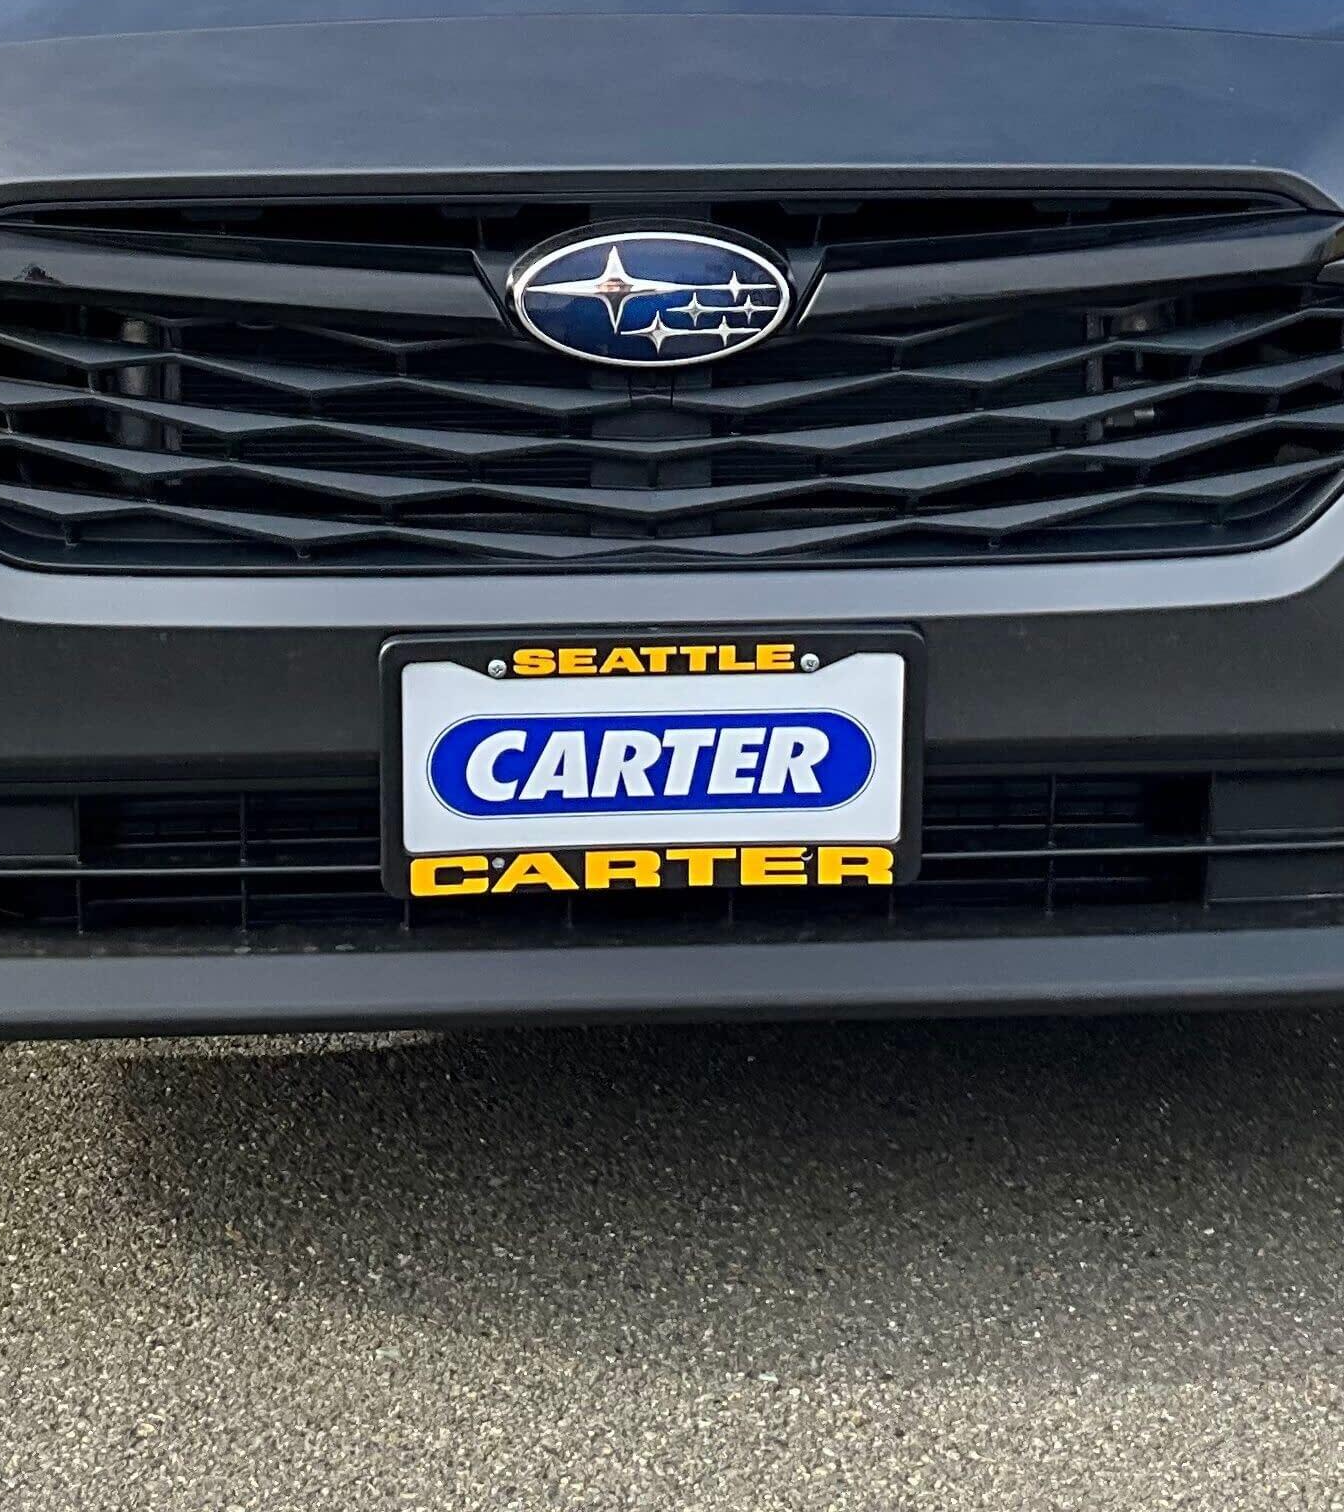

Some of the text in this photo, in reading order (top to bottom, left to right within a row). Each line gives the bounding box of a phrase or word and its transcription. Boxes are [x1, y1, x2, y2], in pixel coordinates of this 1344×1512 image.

[513, 644, 795, 676] SEATTLE
[466, 726, 829, 802] CARTER
[410, 846, 894, 897] CARTER
